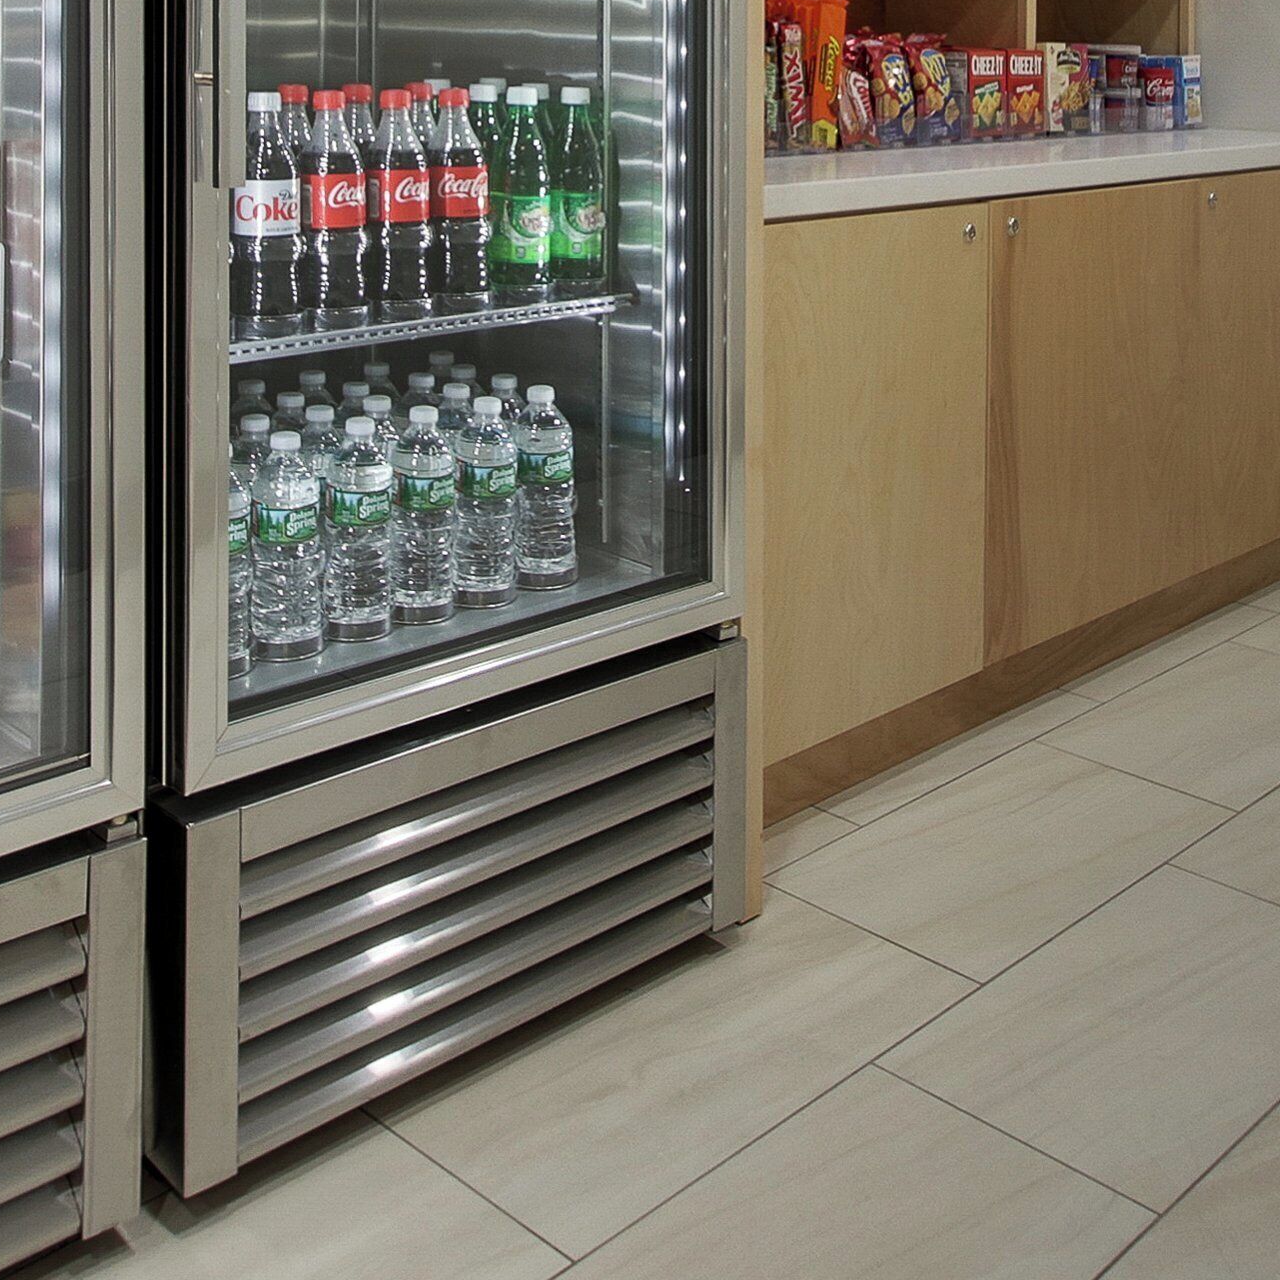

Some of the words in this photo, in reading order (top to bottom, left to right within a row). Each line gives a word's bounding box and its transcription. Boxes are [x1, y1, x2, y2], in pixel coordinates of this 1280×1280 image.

[824, 35, 840, 92] Reese's
[972, 56, 1004, 76] CHEEZ-IT
[1010, 56, 1043, 76] CHEEZ-IT
[784, 49, 806, 138] TWIX
[235, 194, 298, 222] Coke
